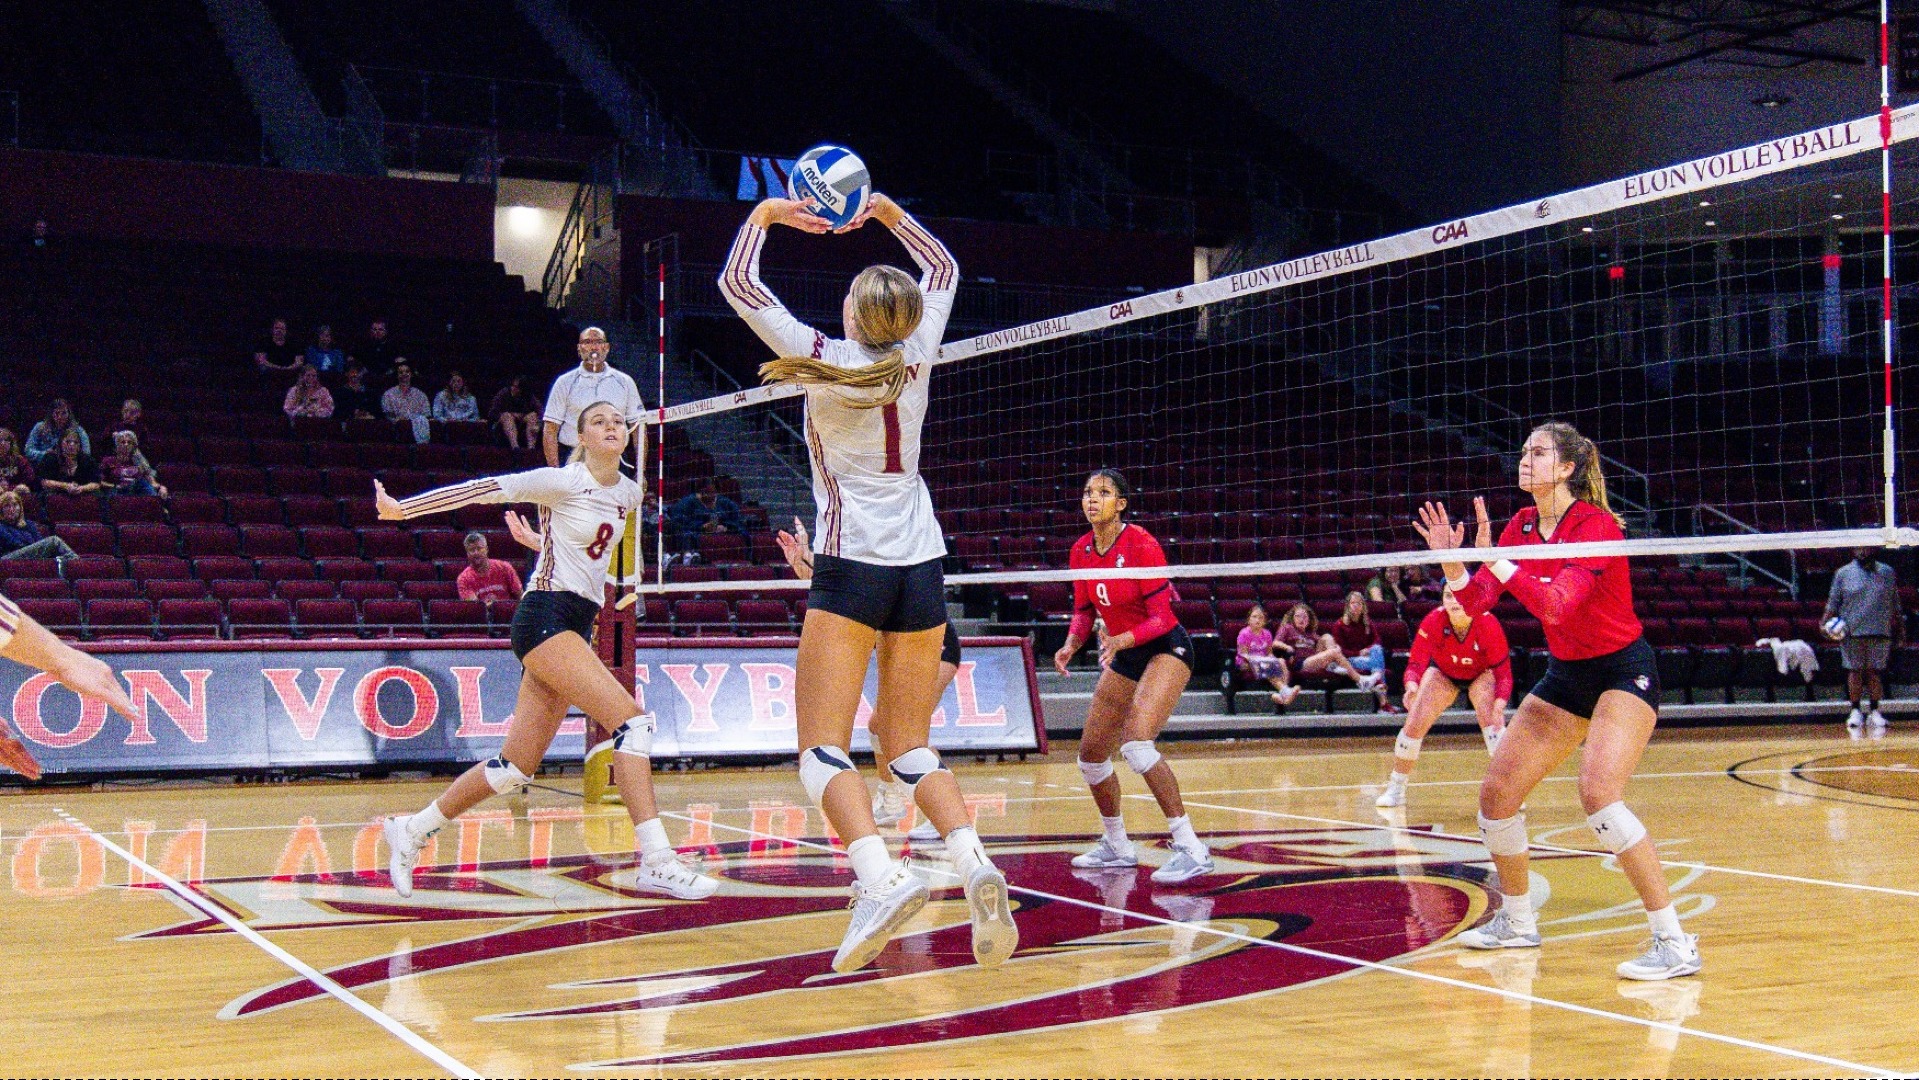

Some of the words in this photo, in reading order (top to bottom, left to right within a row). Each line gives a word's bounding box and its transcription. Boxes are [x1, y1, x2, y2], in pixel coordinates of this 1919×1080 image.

[1623, 165, 1687, 200] ELON
[1693, 122, 1861, 183] VOLLEYBALL
[804, 167, 838, 207] molten
[1432, 220, 1469, 244] CAA
[1231, 268, 1271, 293] ELON
[1272, 242, 1375, 283] VOLLEYBALL
[1110, 301, 1134, 320] CAA
[974, 331, 1001, 351] ELON
[1003, 316, 1071, 345] VOLLEYBALL
[587, 522, 614, 560] 8
[1096, 582, 1111, 607] 9
[13, 669, 213, 748] ON
